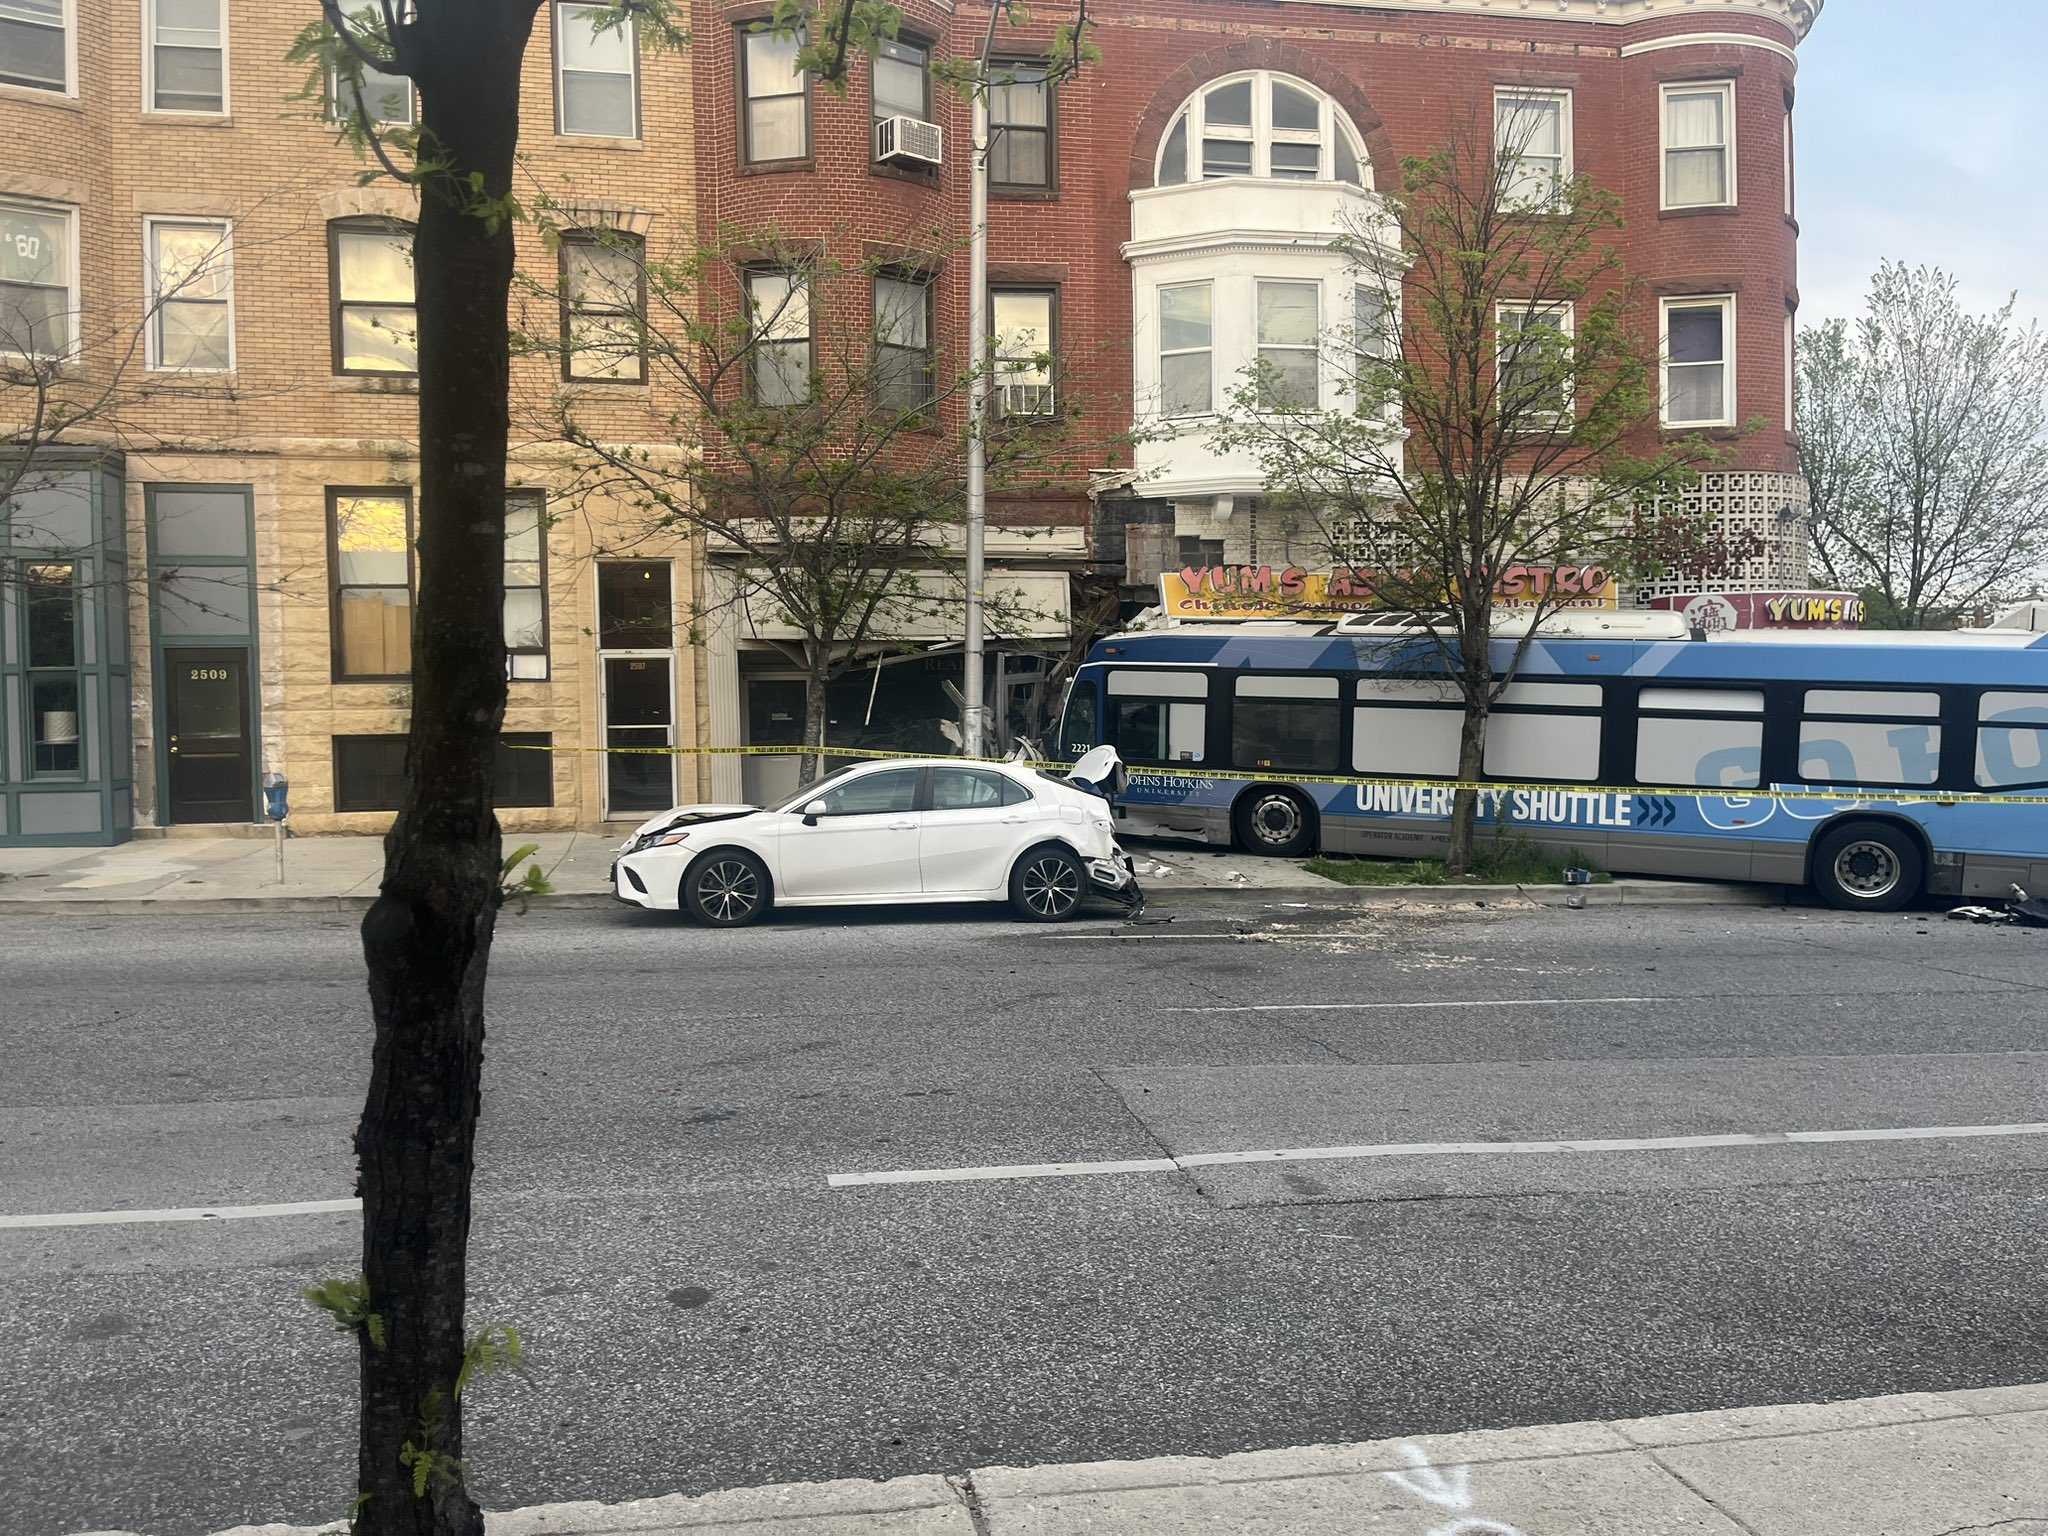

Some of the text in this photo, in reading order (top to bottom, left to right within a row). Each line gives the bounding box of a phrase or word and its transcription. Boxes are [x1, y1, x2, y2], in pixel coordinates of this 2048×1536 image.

[16, 234, 40, 260] 60
[191, 669, 227, 680] 2509
[1071, 743, 1090, 753] 2221
[1126, 775, 1214, 790] JOHNS HOPKINS
[1356, 785, 1632, 827] UNIVERTY SHUTTLE
